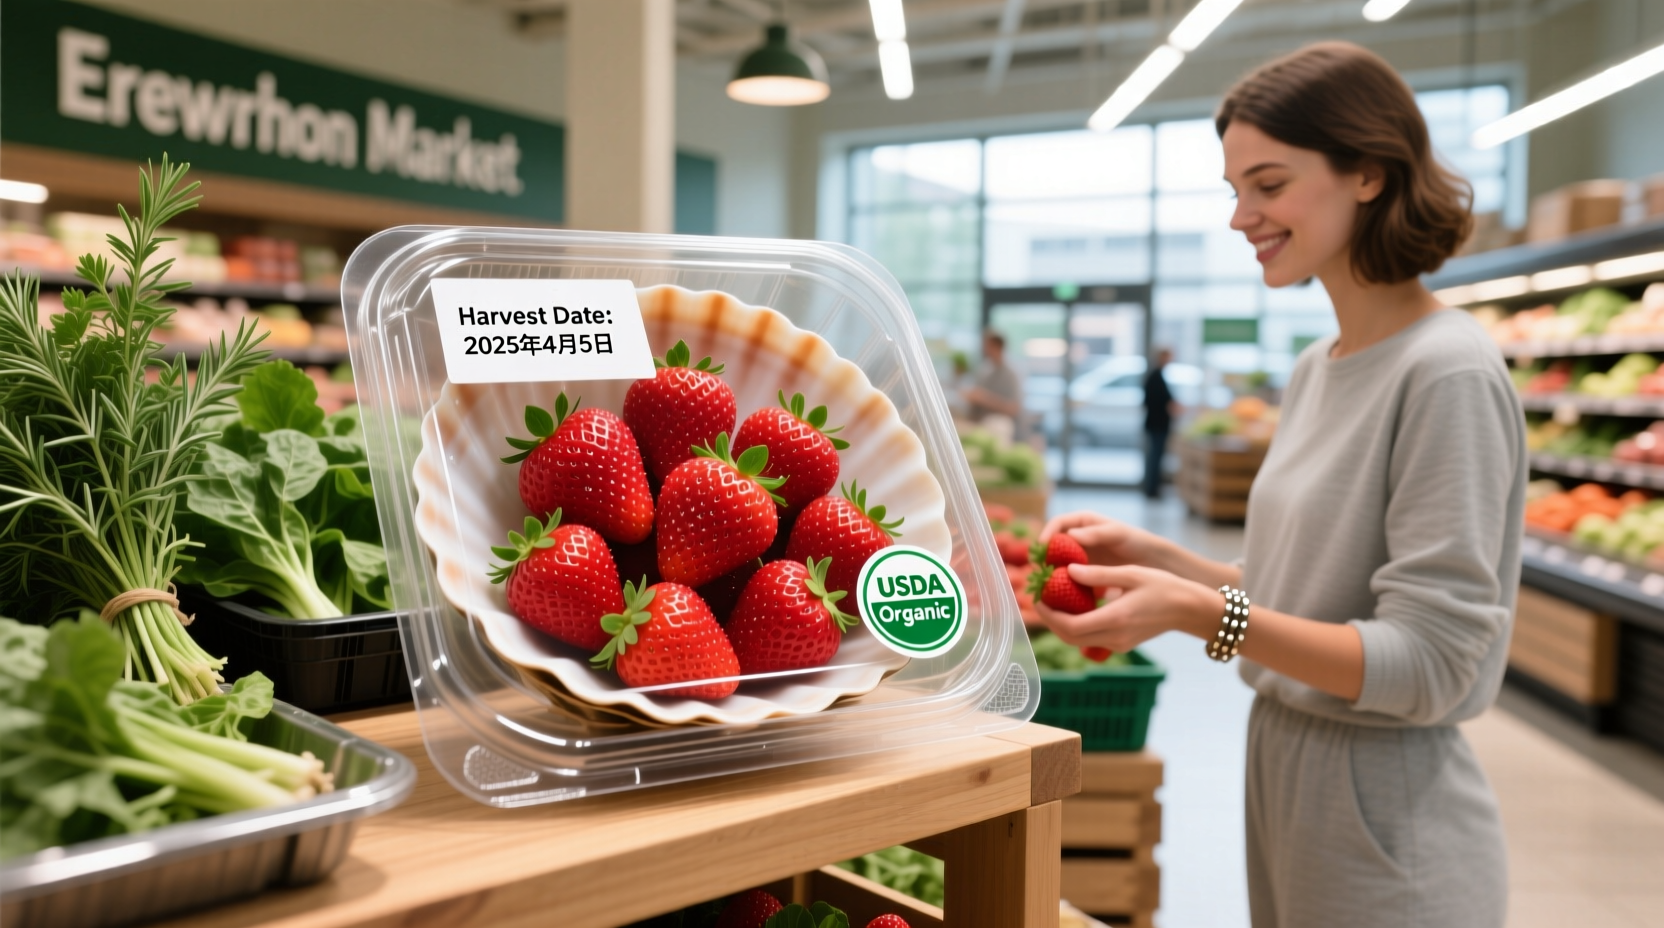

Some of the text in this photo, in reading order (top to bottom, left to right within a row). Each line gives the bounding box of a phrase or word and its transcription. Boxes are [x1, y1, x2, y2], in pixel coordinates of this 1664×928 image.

[57, 27, 358, 169] Erewrhon
[458, 306, 613, 326] Harvest Date:
[463, 333, 613, 356] 2025年4月5日
[877, 573, 947, 598] USDA
[879, 601, 951, 627] Organic
